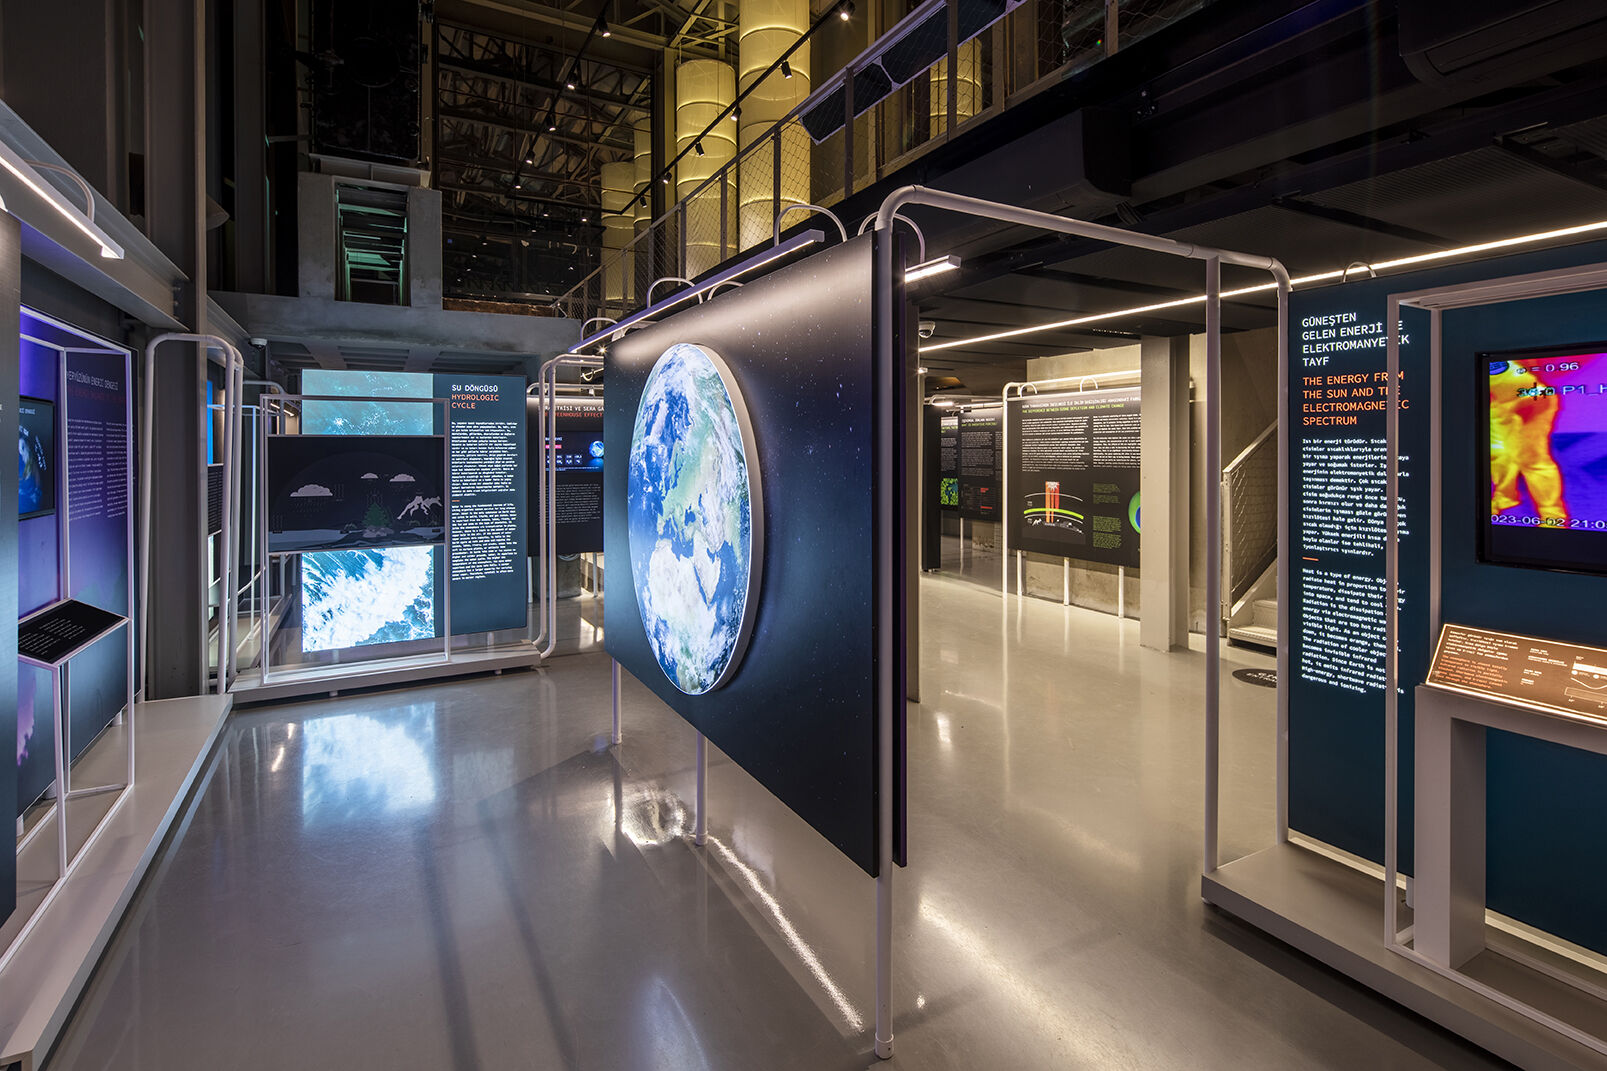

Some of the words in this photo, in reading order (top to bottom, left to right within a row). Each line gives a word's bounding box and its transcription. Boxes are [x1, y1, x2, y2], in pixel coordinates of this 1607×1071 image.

[1302, 312, 1357, 327] GÜNEŞTEN
[1302, 329, 1336, 341] GELEN
[1340, 321, 1383, 337] ENERJİ
[1303, 357, 1330, 367] TAYF
[1545, 362, 1579, 373] 0.96
[1303, 377, 1322, 386] THE
[1327, 373, 1369, 385] ENERGY
[1374, 371, 1405, 382] FRM
[1303, 389, 1322, 399] THE
[1327, 389, 1348, 398] SUN
[1351, 388, 1374, 397] AND
[1303, 416, 1357, 426] SPECTRUM
[1570, 518, 1607, 530] 21:0
